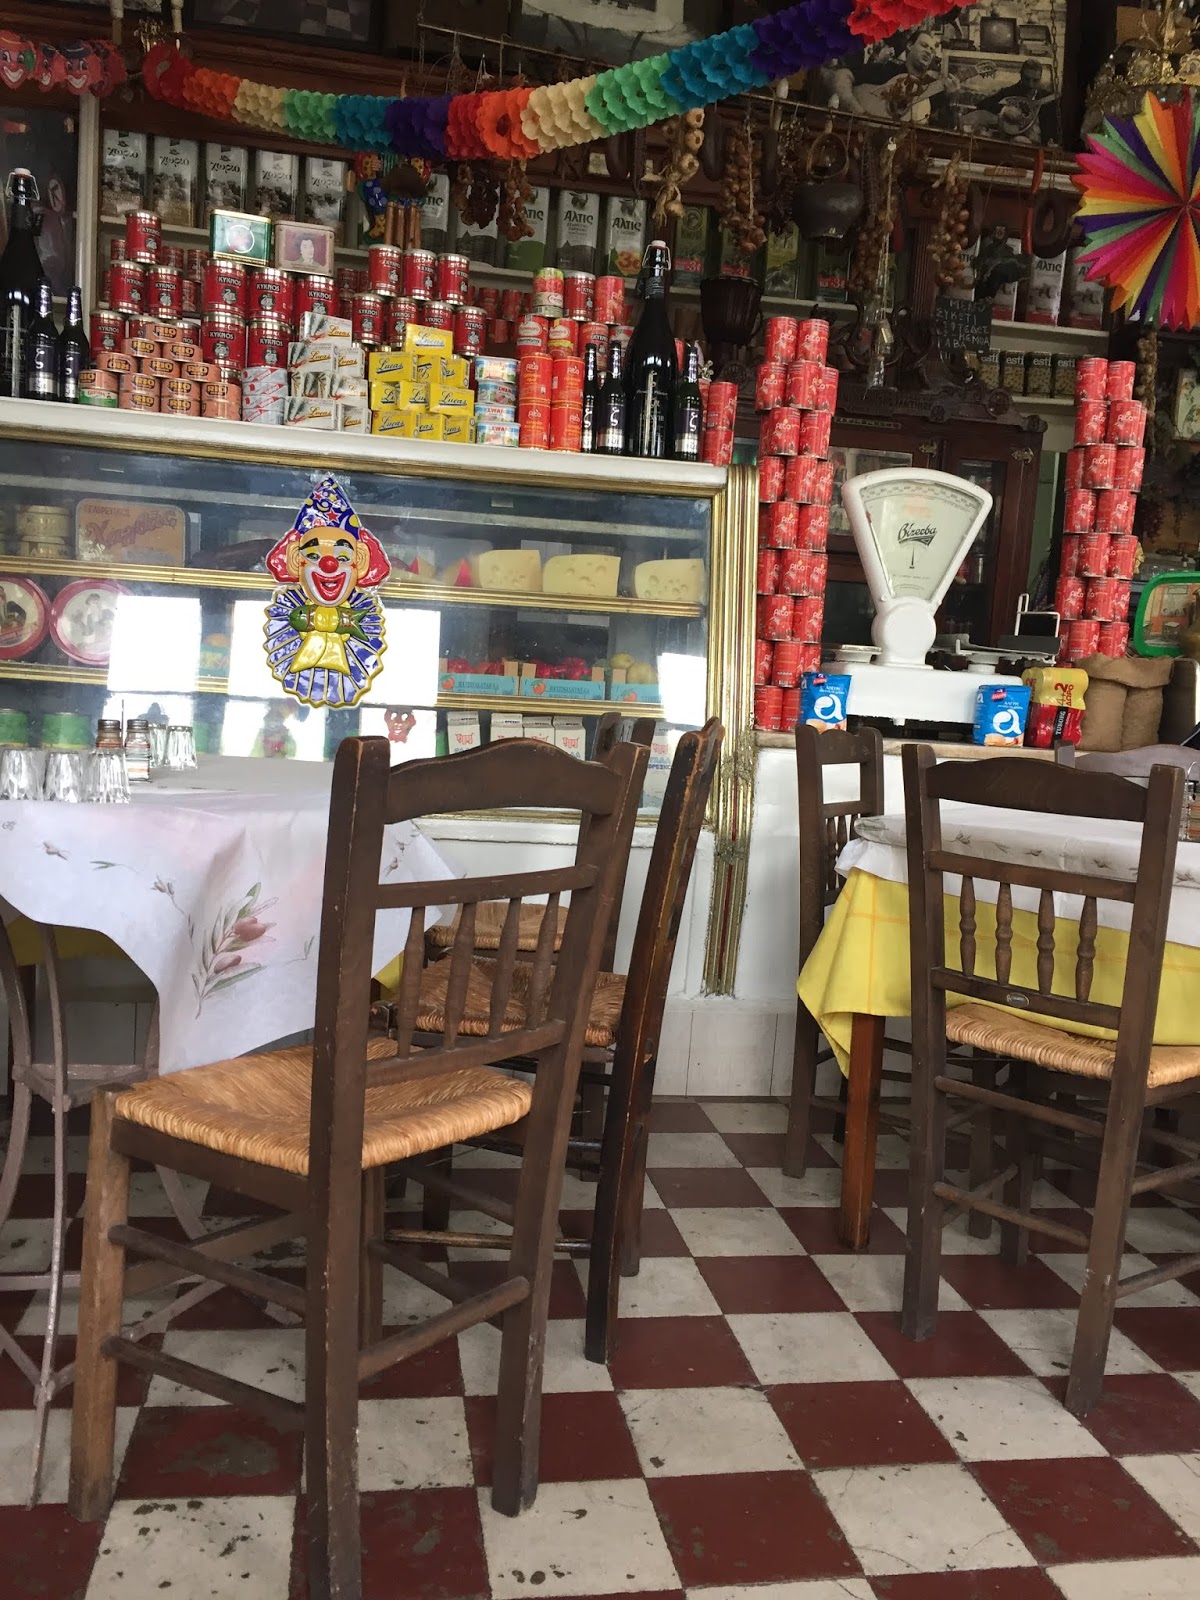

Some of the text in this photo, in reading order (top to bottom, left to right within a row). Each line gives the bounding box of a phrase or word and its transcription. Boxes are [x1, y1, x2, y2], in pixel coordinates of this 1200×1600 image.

[218, 276, 242, 285] KYKNOS
[256, 283, 280, 292] KYKNOS
[155, 326, 176, 335] RIO
[328, 325, 350, 336] Lucas
[210, 332, 234, 340] KYKNOS
[418, 332, 444, 346] Lucas
[133, 342, 154, 350] RIO
[260, 338, 283, 347] KYKNOS
[173, 346, 194, 354] RIO
[310, 351, 331, 361] Lucas
[1006, 356, 1024, 365] esti
[152, 361, 173, 370] RIO
[339, 356, 357, 366] Lucas
[377, 358, 404, 372] Lucas
[1033, 357, 1051, 366] esti
[1058, 359, 1075, 367] esti
[187, 366, 208, 374] RIO
[135, 377, 155, 386] RIO
[170, 382, 191, 390] RIO
[134, 396, 154, 404] RIO
[440, 391, 467, 405] Lucas
[170, 400, 191, 408] RIO
[310, 407, 332, 417] Lucas
[344, 418, 361, 427] Lucas
[380, 417, 405, 431] Lucas
[898, 522, 937, 542] Bizerba
[1055, 683, 1068, 706] 4+2
[1056, 711, 1066, 735] TUBORG
